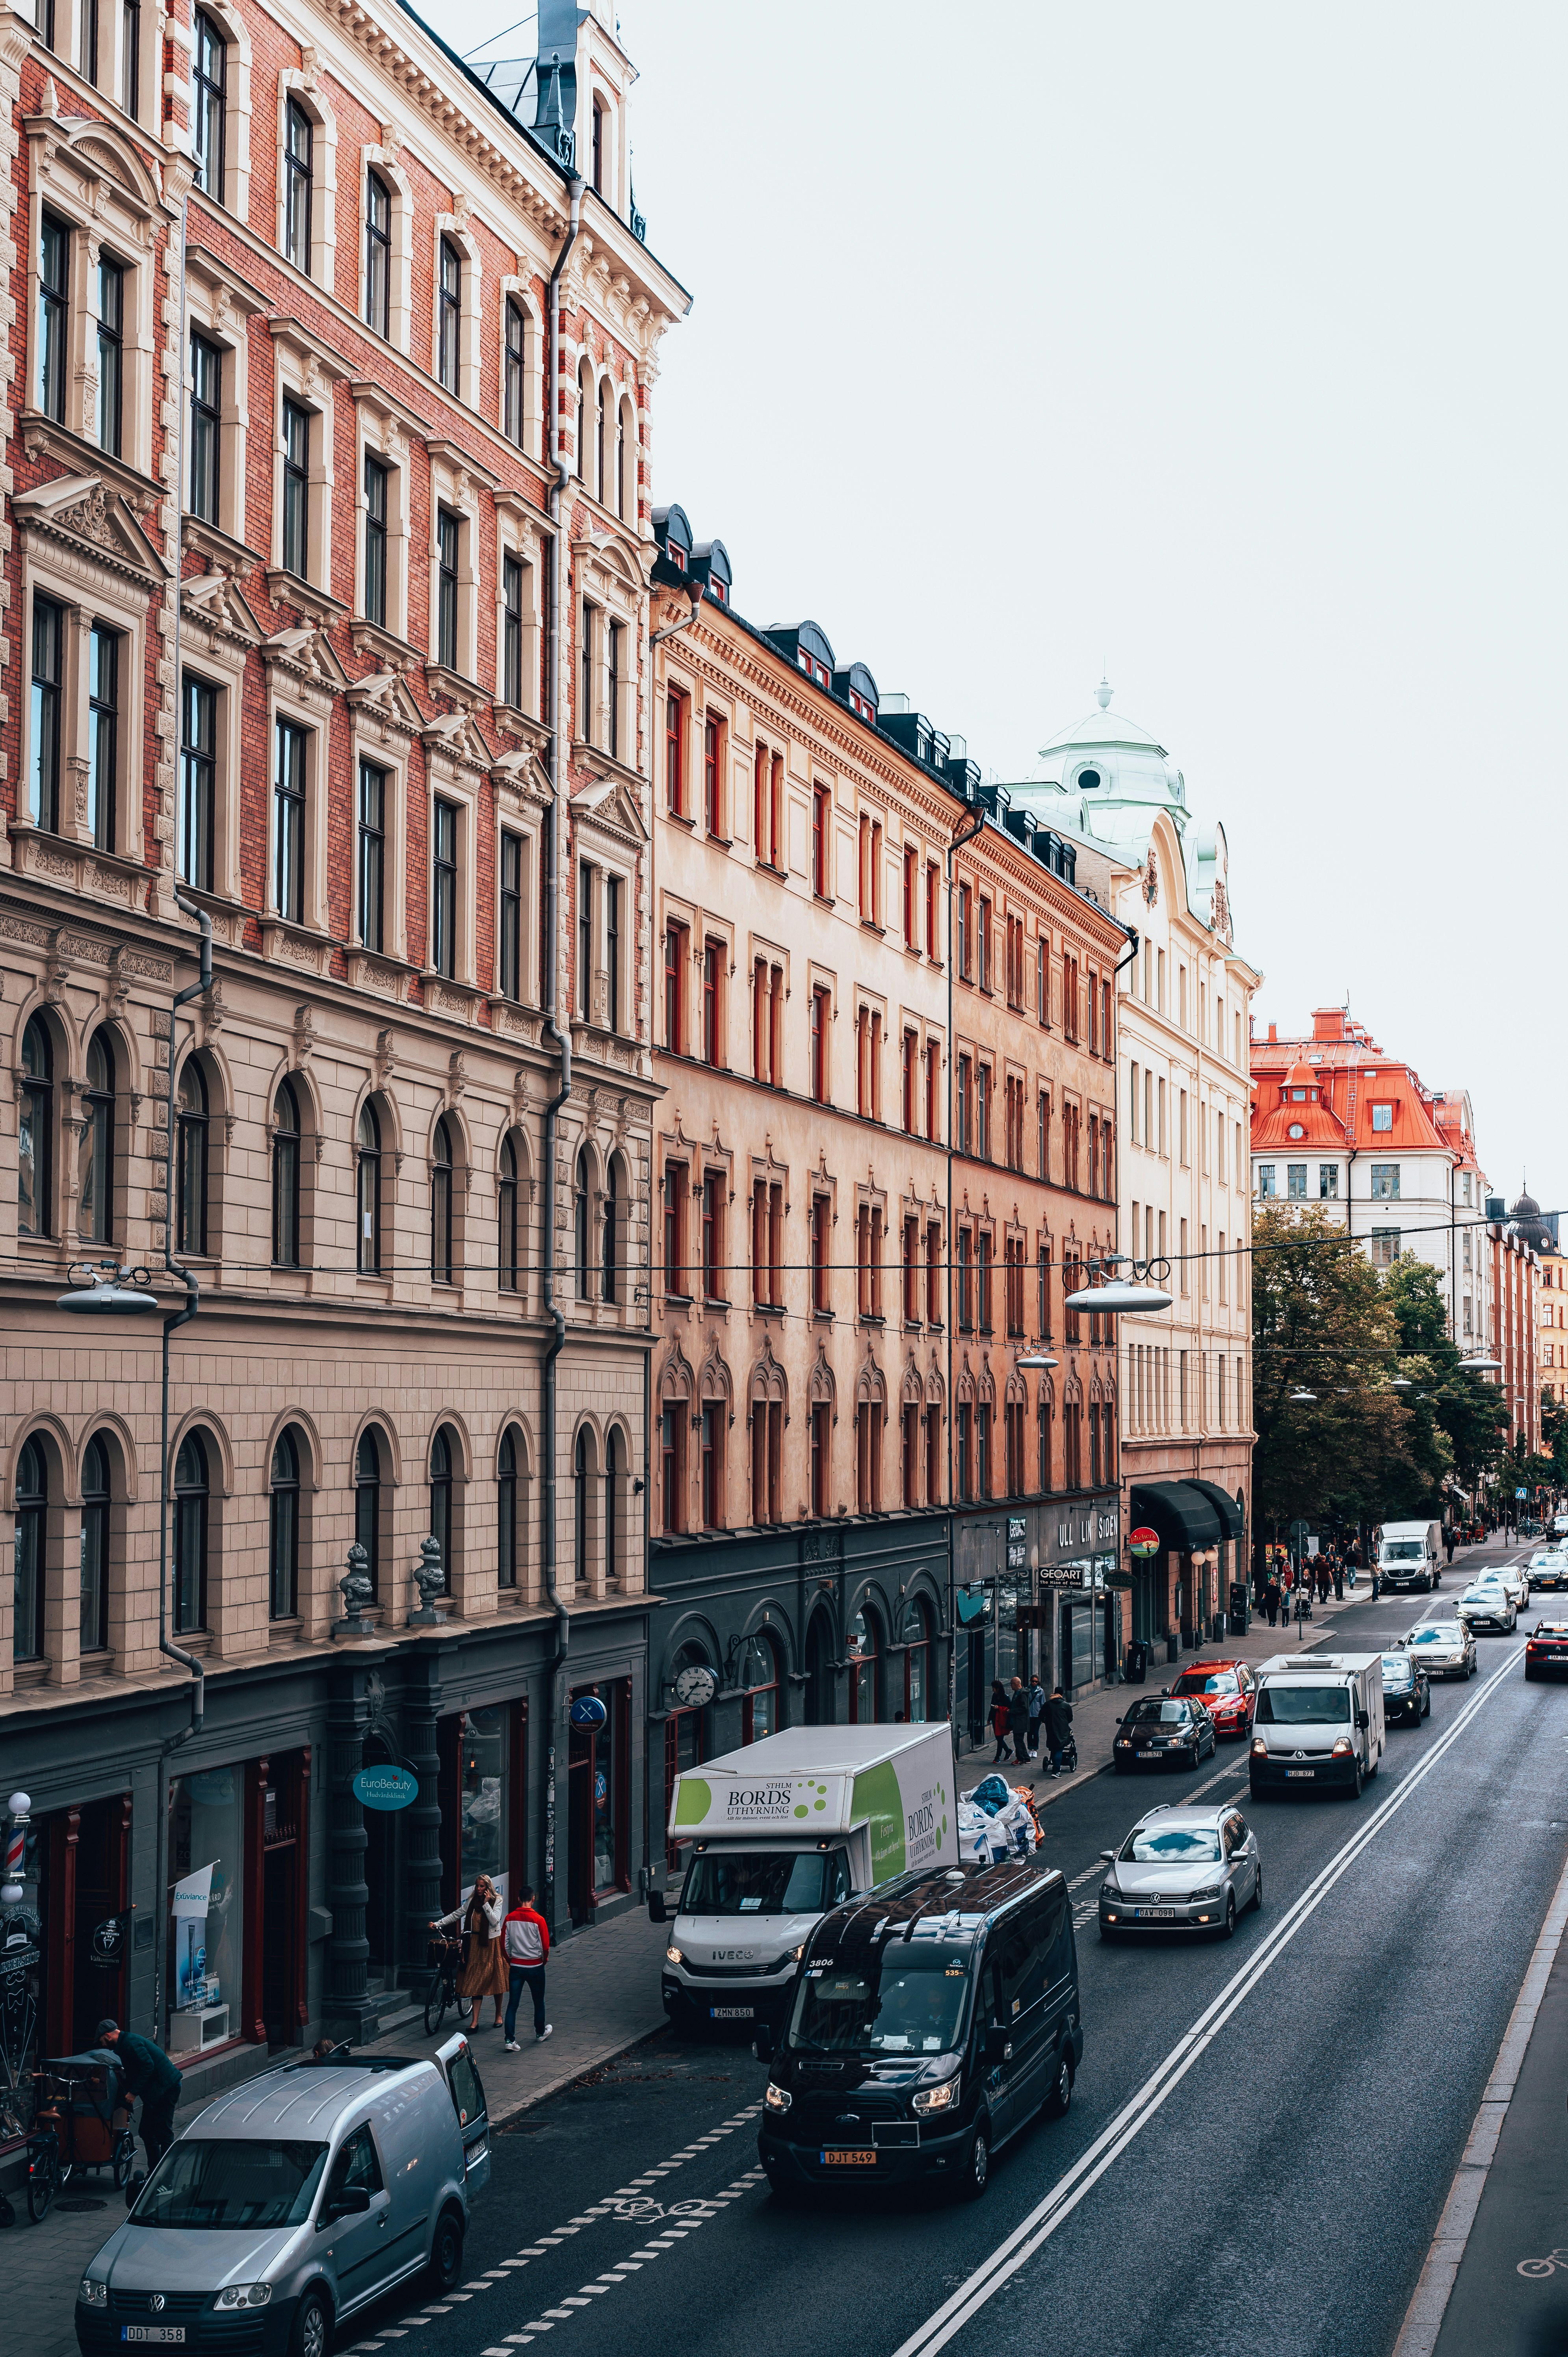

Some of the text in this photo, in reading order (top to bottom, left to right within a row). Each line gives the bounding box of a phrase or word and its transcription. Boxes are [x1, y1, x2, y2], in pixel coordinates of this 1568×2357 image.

[1060, 1515, 1117, 1547] ULL LIN SIDEN
[1040, 1569, 1081, 1579] GEOART
[1107, 1576, 1133, 1585] RUNO
[361, 1778, 411, 1790] EuroBeauty
[728, 1790, 791, 1805] BORDS
[921, 1789, 932, 1804] STHLM
[727, 1806, 790, 1815] UTHYRNING
[908, 1803, 933, 1841] BORDS
[910, 1832, 934, 1858] UTHYRNING
[175, 1892, 207, 1901] Exuviance
[713, 1950, 754, 1960] IVECO
[809, 1959, 834, 1967] 3806
[829, 2153, 872, 2163] DJT 549
[129, 2327, 150, 2340] DDT
[160, 2329, 182, 2340] 358
